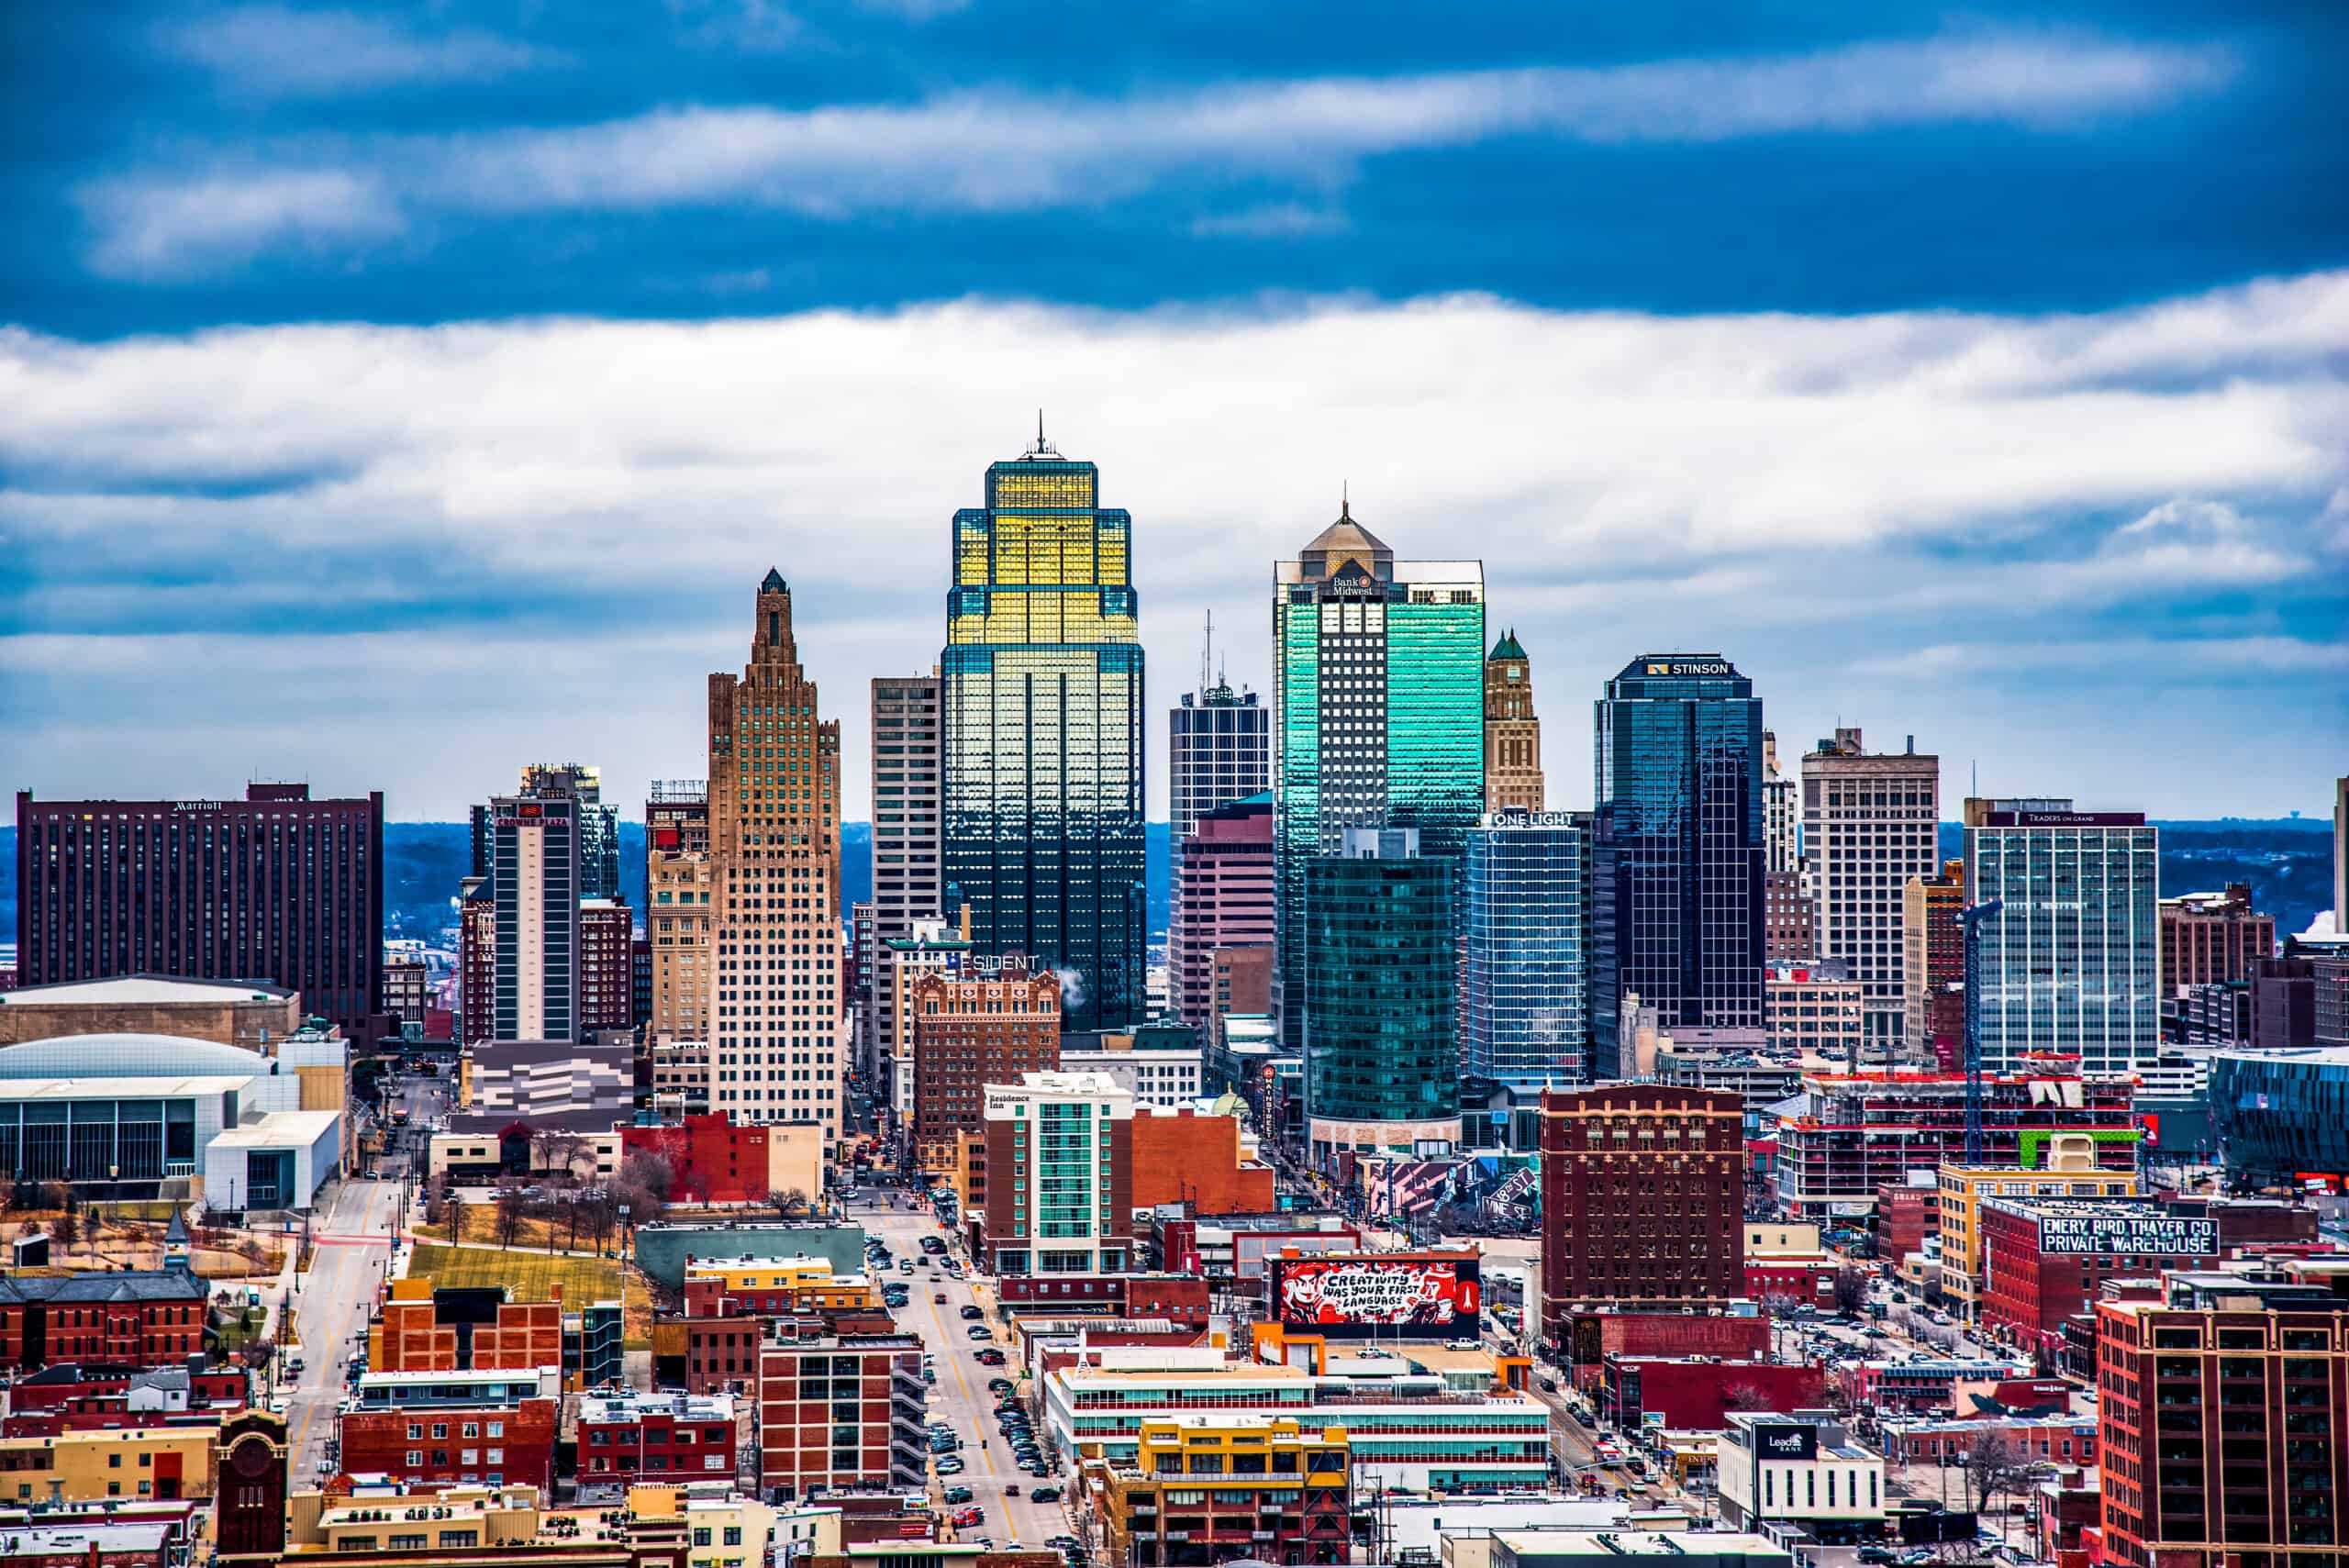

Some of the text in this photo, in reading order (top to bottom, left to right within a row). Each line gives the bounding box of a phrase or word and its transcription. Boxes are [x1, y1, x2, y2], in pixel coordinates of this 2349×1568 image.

[1333, 577, 1358, 587] Bank
[1333, 587, 1373, 595] Midwest
[1673, 663, 1729, 674] STINSON
[173, 801, 221, 811] Marriott
[497, 818, 567, 827] CROWNE PLAZA
[1495, 813, 1574, 826] ONE LIGHT
[1486, 1199, 1509, 1218] VINE
[2043, 1218, 2217, 1237] EMERY BIRD THAYER CO.
[2045, 1236, 2210, 1253] PRIVATE WAREHOUSE
[1328, 1275, 1408, 1286] CREATIVITY
[1323, 1284, 1419, 1297] WAS YOUR FIRST
[1343, 1296, 1402, 1307] LANGUAGE
[1769, 1435, 1792, 1447] Lead
